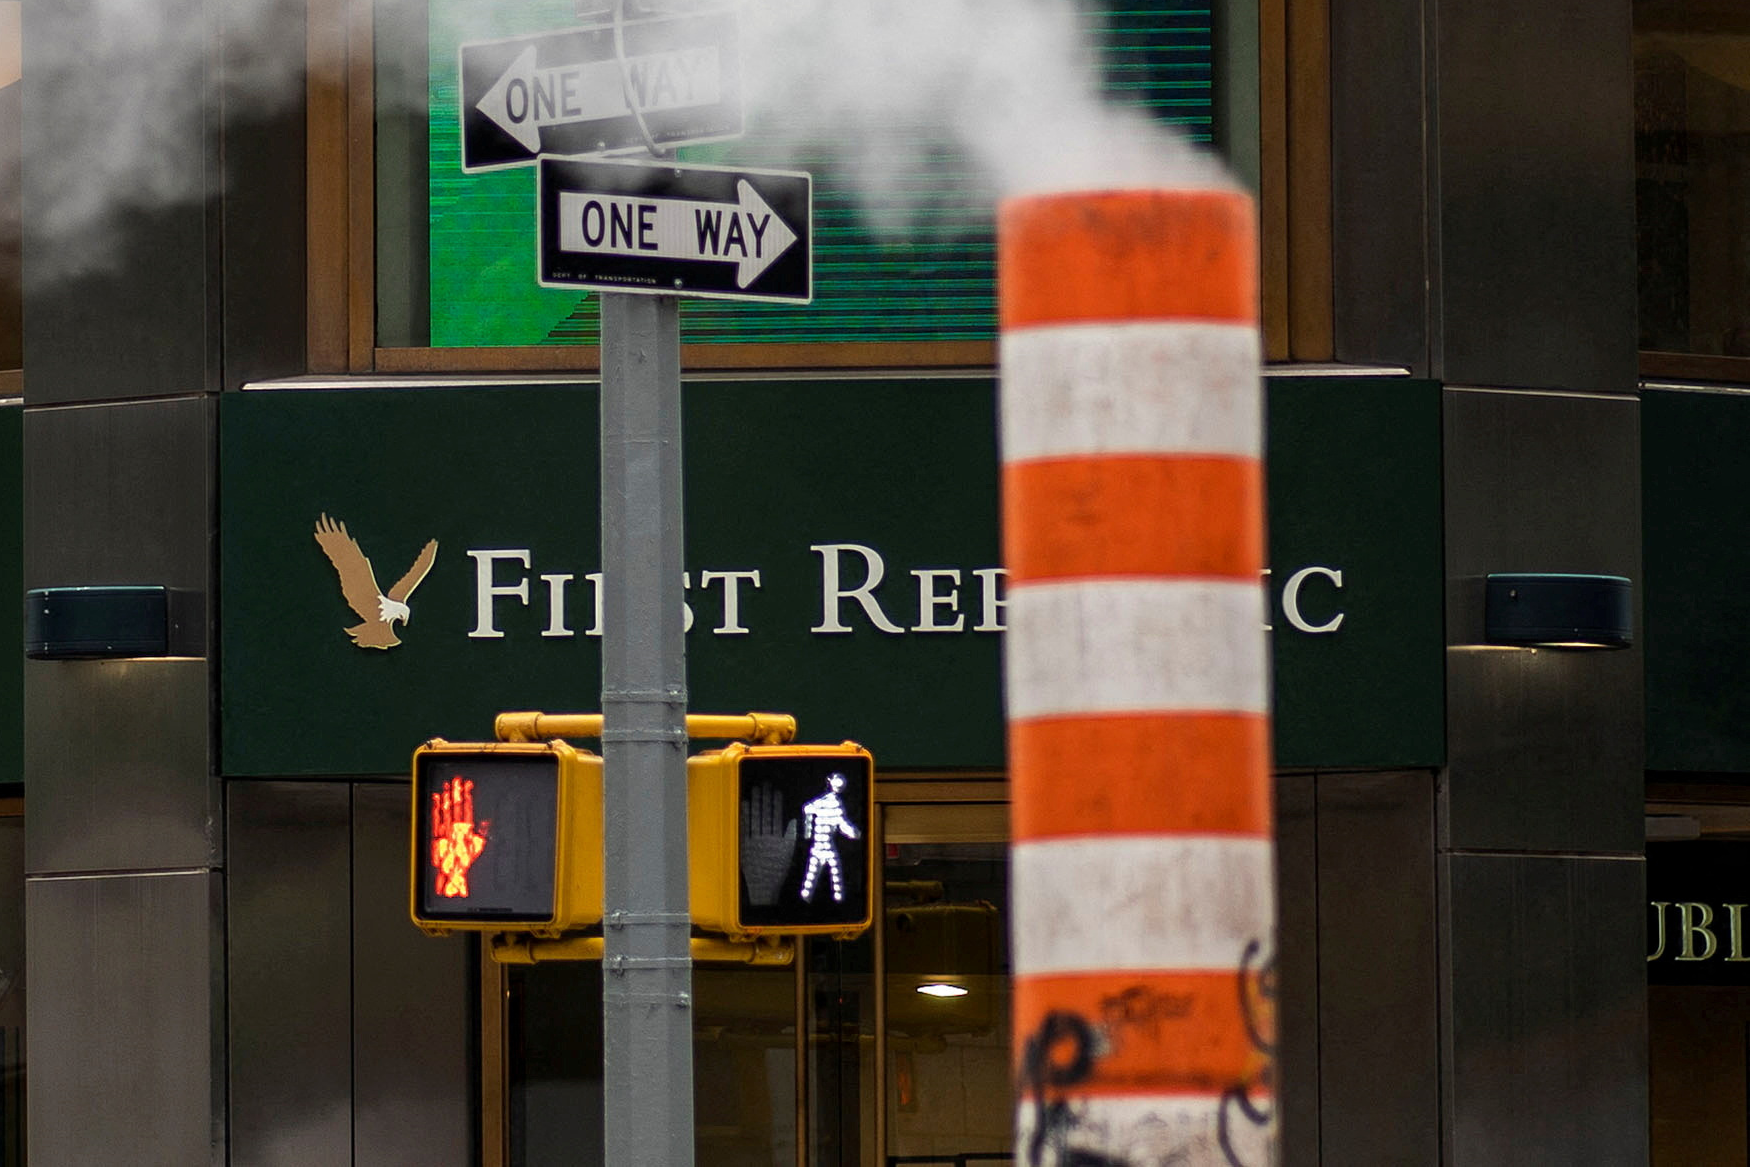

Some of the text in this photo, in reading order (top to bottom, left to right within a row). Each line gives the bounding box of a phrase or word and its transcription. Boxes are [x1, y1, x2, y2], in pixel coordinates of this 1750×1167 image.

[505, 71, 582, 124] ONE
[581, 200, 771, 259] ONE WAY
[466, 548, 762, 638] FIT
